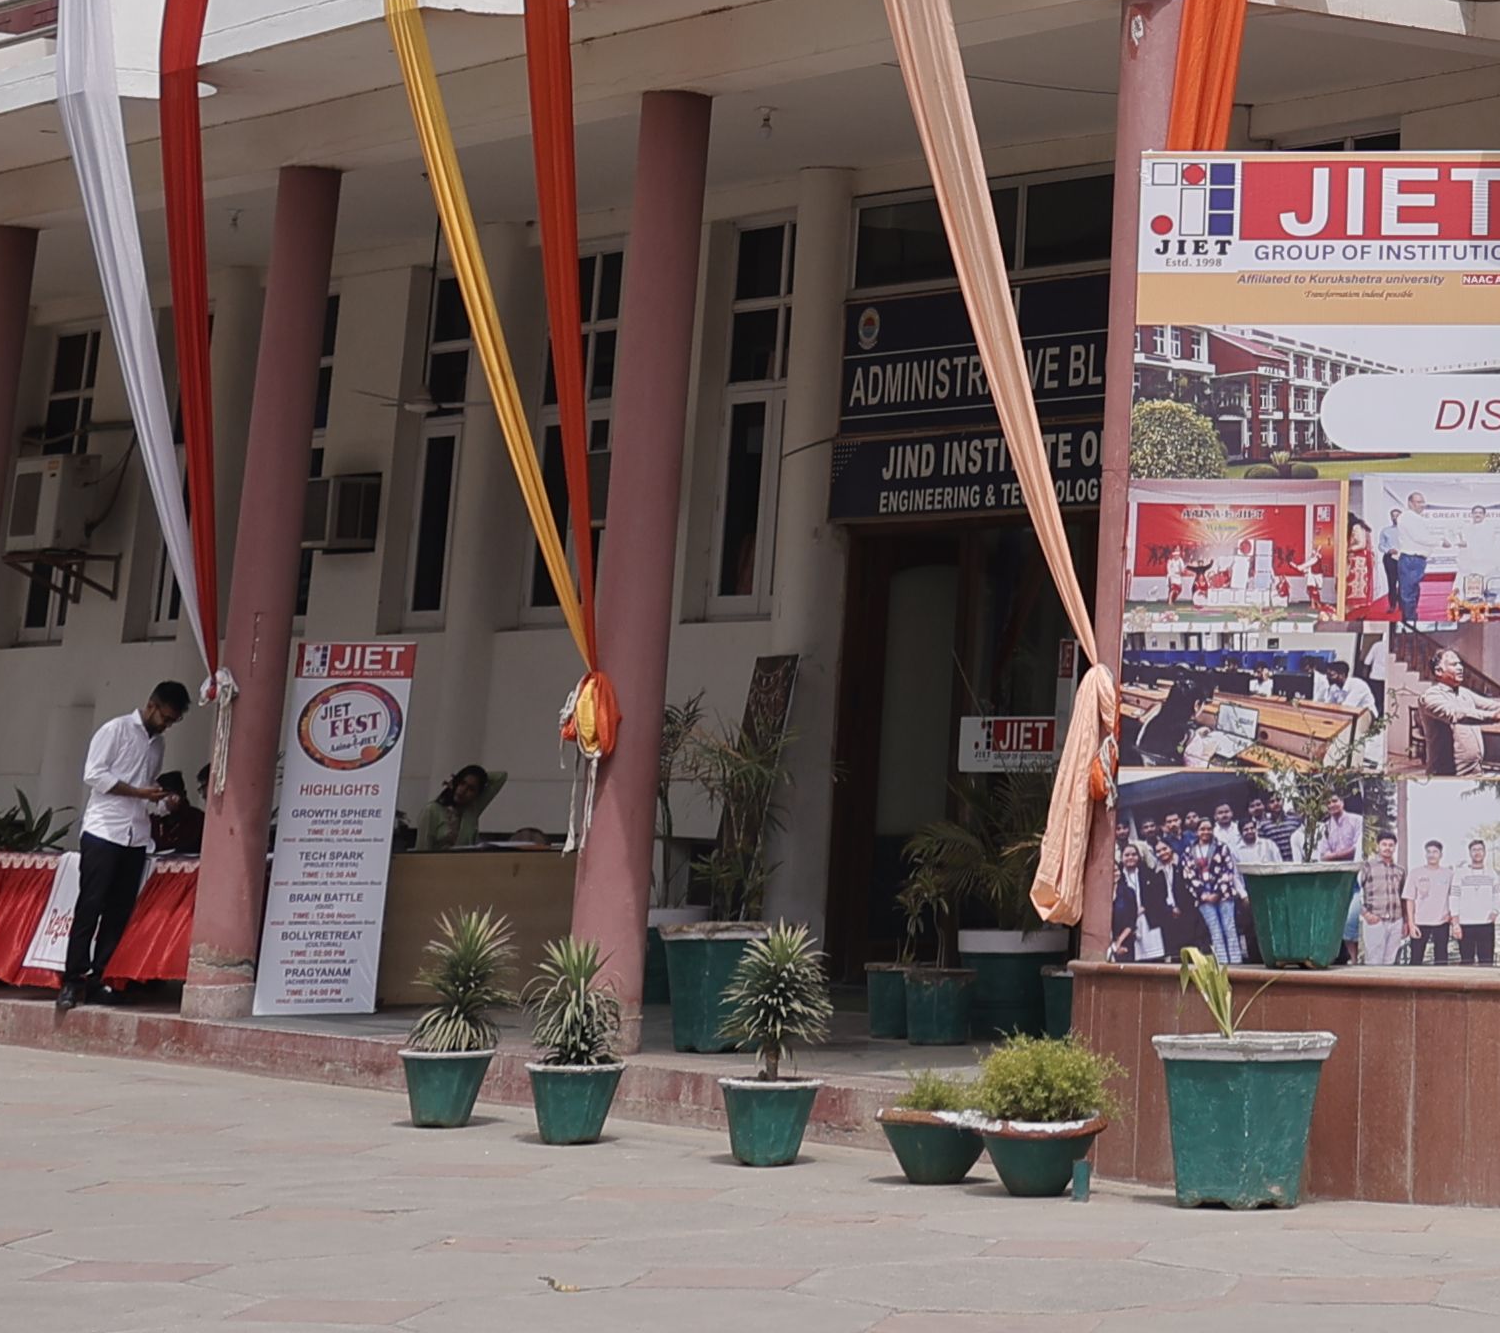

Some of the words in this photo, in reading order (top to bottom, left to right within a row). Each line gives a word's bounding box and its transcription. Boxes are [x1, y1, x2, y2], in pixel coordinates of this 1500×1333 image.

[1155, 239, 1232, 256] JIET
[1254, 244, 1335, 261] GROUP
[1342, 244, 1373, 261] OF
[1165, 258, 1193, 267] Estd.
[1195, 258, 1222, 267] 1998
[1237, 274, 1292, 284] Affiliated
[1294, 275, 1306, 284] to
[1308, 274, 1382, 284] Kurukshetra
[1385, 274, 1445, 286] university
[1462, 275, 1493, 284] NAAC
[849, 346, 1060, 407] ADMINISTRVE
[882, 443, 936, 481] JIND
[942, 433, 1072, 477] INSTITE
[1080, 431, 1104, 466] O
[879, 485, 981, 514] ENGINEERING
[985, 484, 996, 507] &
[1001, 478, 1103, 506] TEOLOG
[334, 646, 405, 669] JIET
[320, 702, 351, 721] JIET
[330, 712, 381, 738] FEST
[1000, 722, 1048, 750] JIET
[300, 784, 380, 796] HIGHLIGHTS
[291, 809, 338, 819] GROWTH
[340, 809, 382, 818] SPHERE
[299, 851, 326, 861] TECH
[329, 851, 364, 861] SPARK
[289, 893, 320, 903] BRAIN
[324, 893, 364, 902] BATTLE
[281, 931, 363, 941] BOLLYRETREAT
[284, 967, 351, 977] PRAGYANAM
